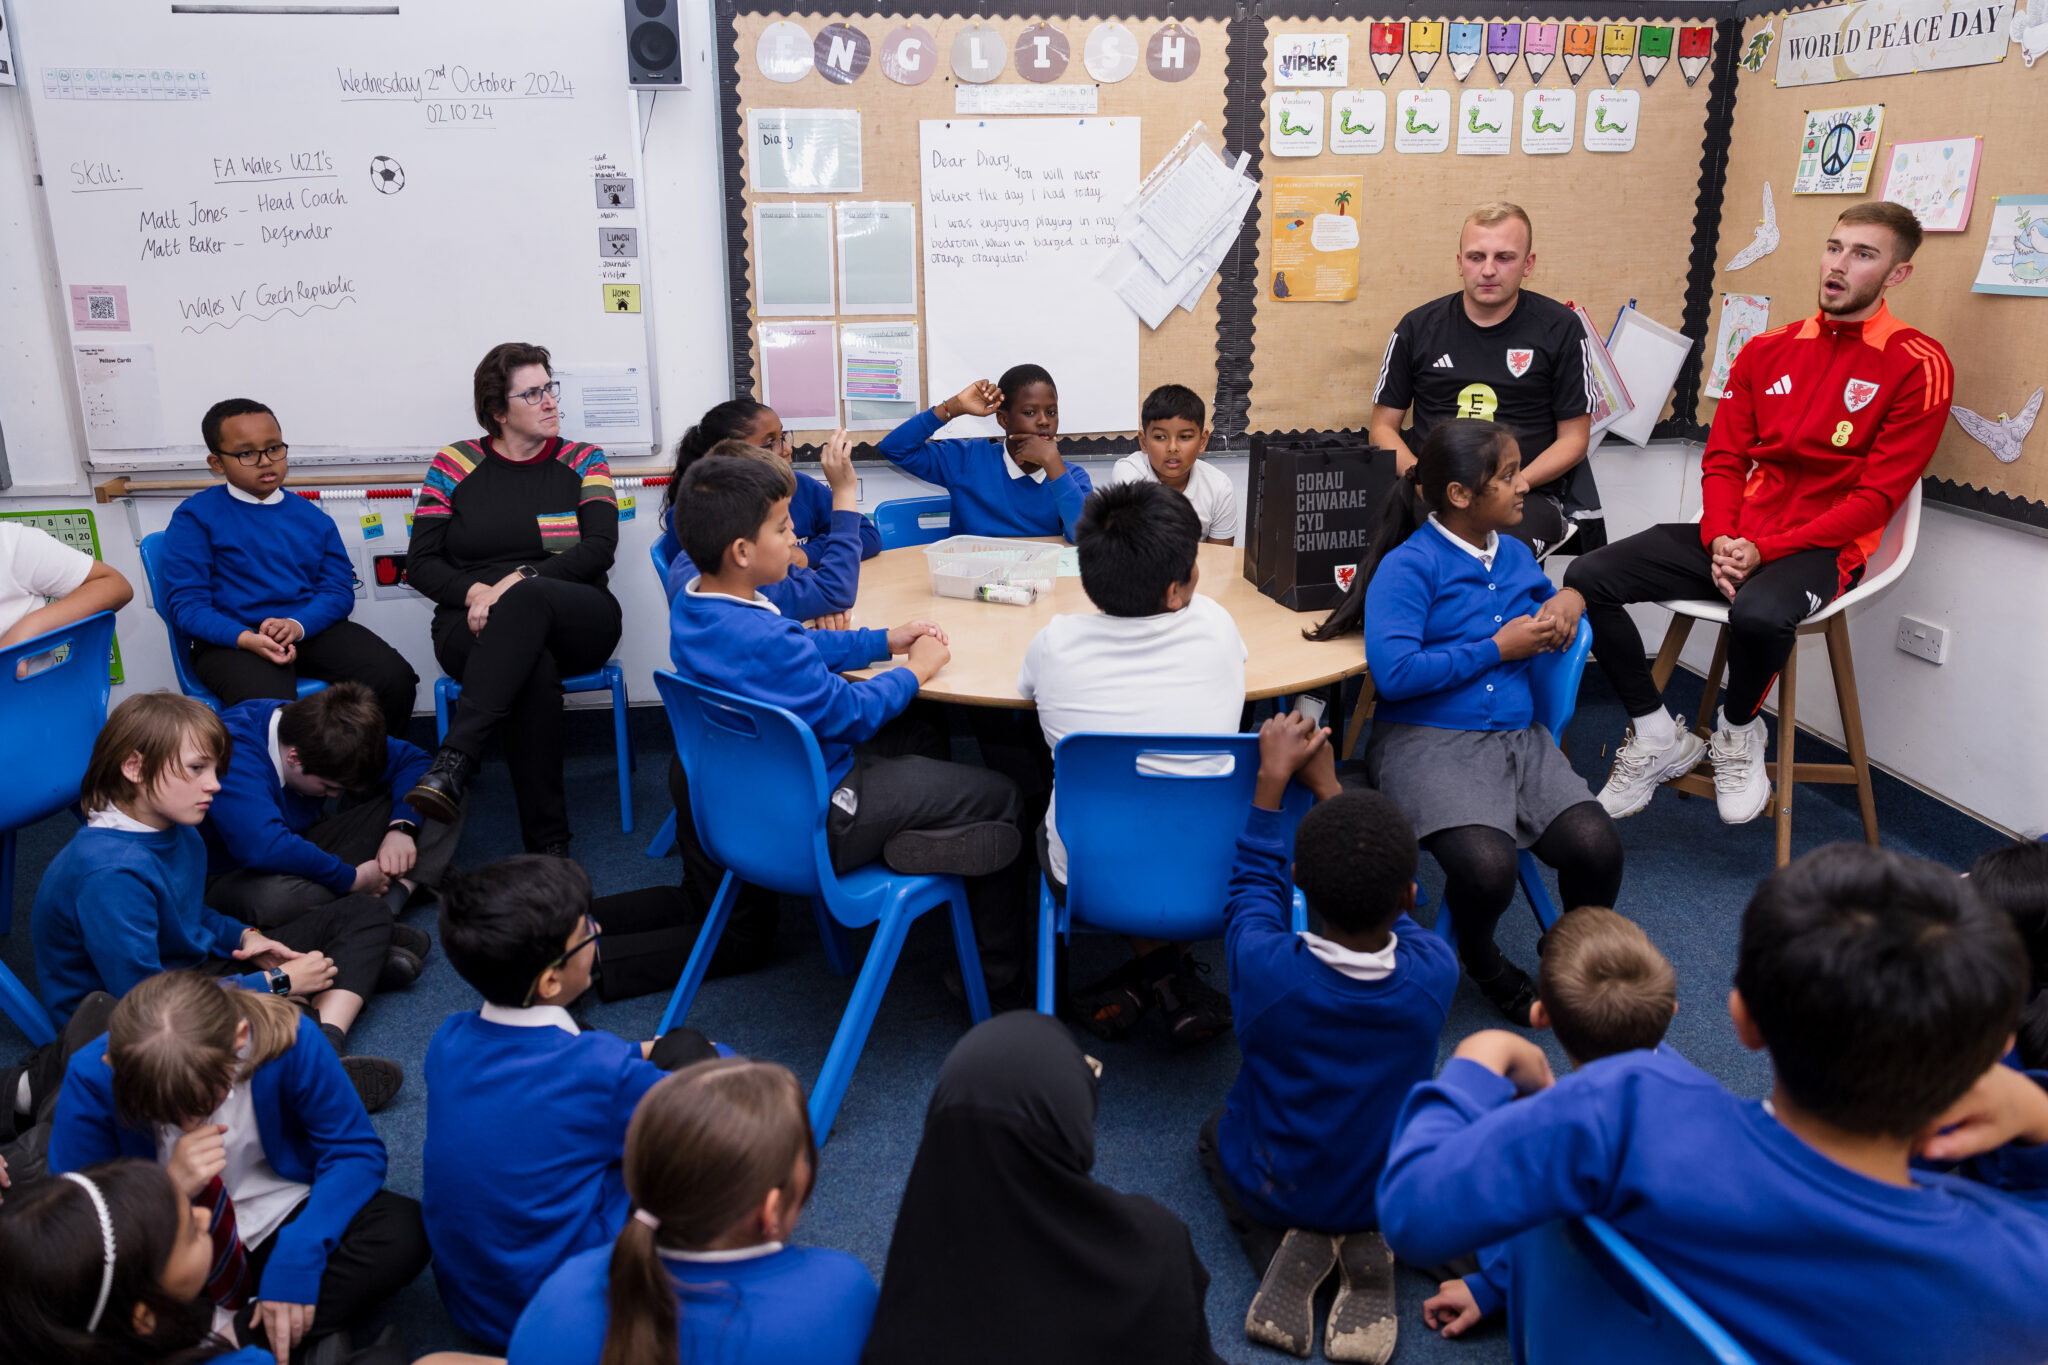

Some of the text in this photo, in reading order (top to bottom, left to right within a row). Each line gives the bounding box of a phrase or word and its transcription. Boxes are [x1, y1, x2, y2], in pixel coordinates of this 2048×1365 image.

[1788, 5, 2004, 62] WORLD PEACE DAY
[337, 66, 423, 103] Wednesday
[452, 66, 517, 92] October
[524, 71, 576, 96] 2024
[427, 104, 494, 123] 02 10 24
[763, 133, 794, 150] Diay
[214, 151, 333, 178] FA Wales U21's
[931, 149, 966, 169] Dear
[1014, 167, 1101, 181] You will never
[929, 187, 972, 202] believe
[978, 187, 1000, 201] the
[1004, 189, 1024, 205] day
[1042, 187, 1066, 200] had
[139, 209, 181, 232] Matt
[188, 200, 228, 227] Jones
[258, 192, 295, 213] Head
[301, 188, 348, 209] Coach
[933, 215, 1117, 232] I was enjoying playing in my
[141, 238, 181, 261] Matt
[189, 235, 226, 254] Baker
[261, 223, 333, 248] Defender
[606, 232, 630, 242] LUNCH
[1014, 239, 1025, 248] in
[1033, 236, 1074, 251] barged
[1080, 237, 1088, 246] a
[1095, 234, 1121, 249] bright
[931, 252, 965, 267] orange
[179, 296, 224, 319] Wales
[256, 282, 293, 307] Czech
[297, 275, 356, 302] Republic
[612, 288, 631, 298] HOME
[1296, 470, 1344, 492] GORAU
[1296, 489, 1367, 512] CHWARAE
[30, 519, 36, 527] 7
[65, 518, 71, 526] 9
[78, 517, 87, 525] 10
[365, 516, 377, 524] 0.3
[1296, 513, 1324, 532] CYD
[64, 533, 74, 541] 19
[79, 533, 90, 541] 20
[1296, 529, 1371, 552] CHWARAE.
